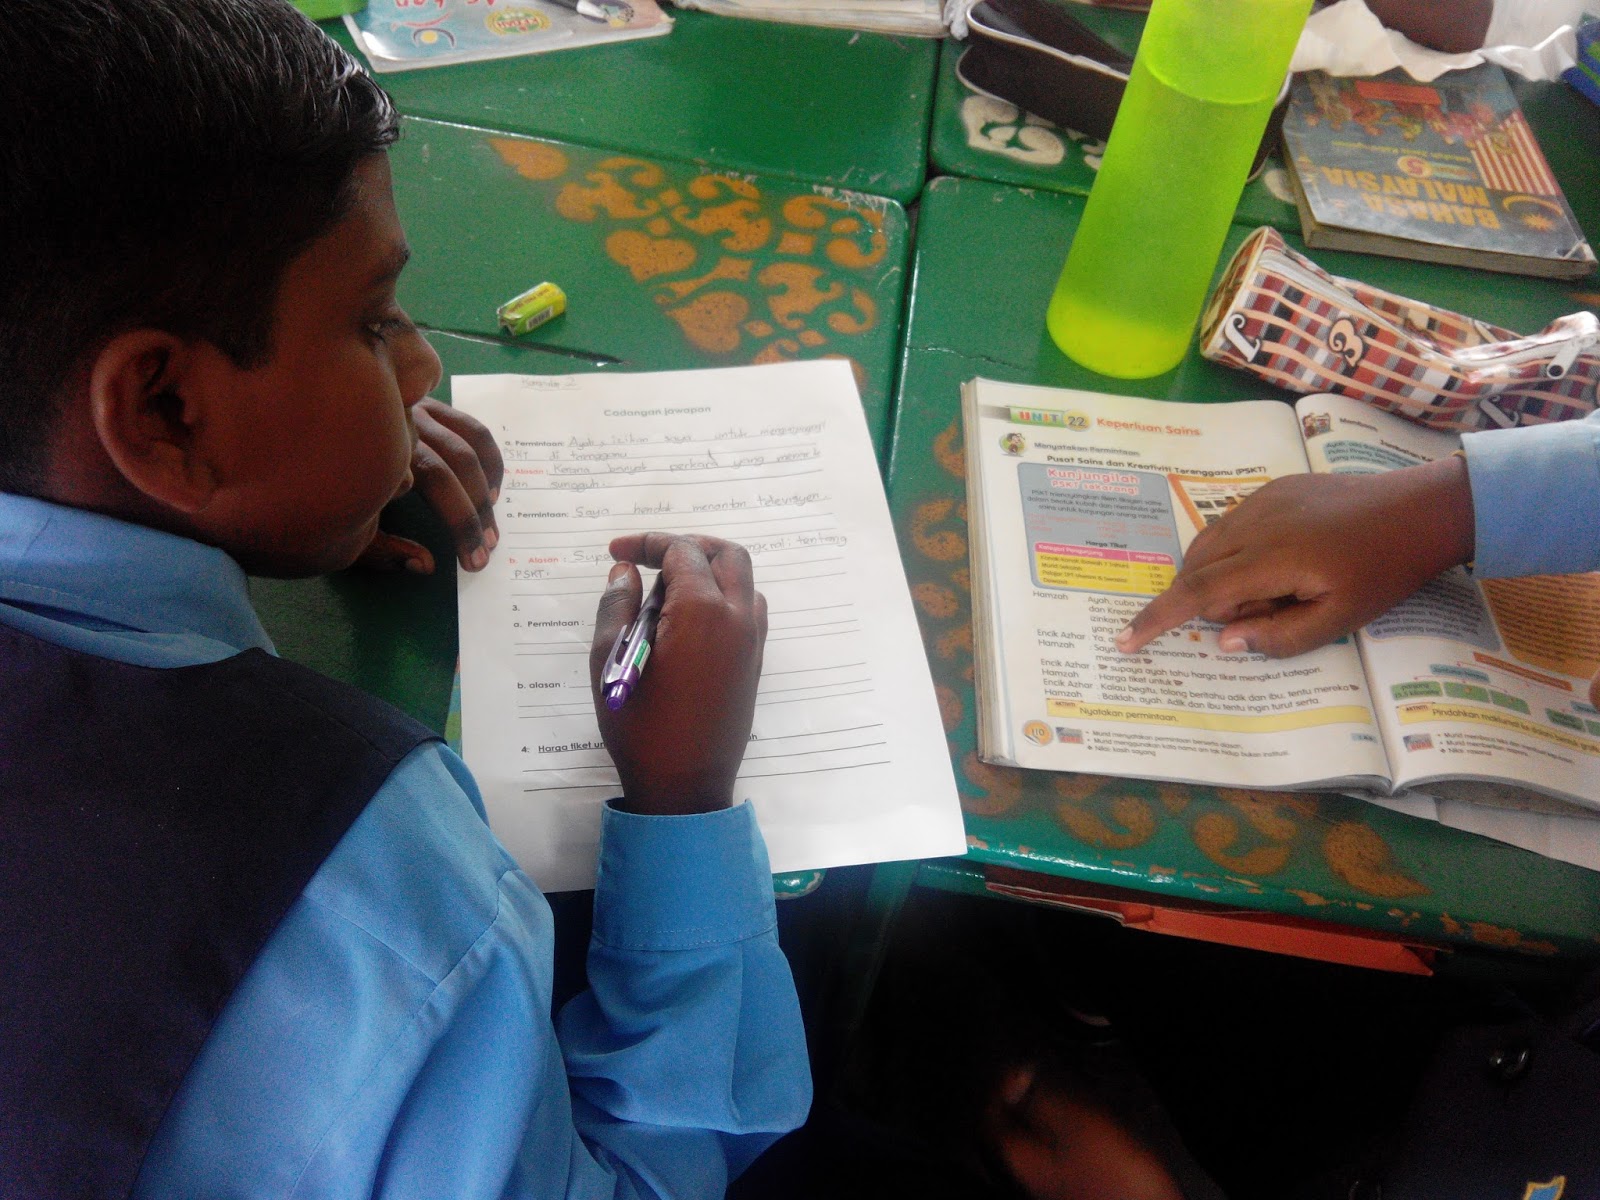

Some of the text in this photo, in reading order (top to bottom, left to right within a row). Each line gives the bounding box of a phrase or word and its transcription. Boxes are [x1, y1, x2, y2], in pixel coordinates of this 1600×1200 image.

[1321, 166, 1491, 207] MALAYSIA
[1362, 193, 1501, 230] BAHASA
[604, 405, 711, 417] Cadangan jawapan
[1019, 411, 1200, 435] UNIT 22 Keperluan Sains
[1048, 468, 1139, 484] Kunjungilah
[1127, 462, 1171, 472] Kreativiti
[1175, 467, 1233, 477] Terengganu
[1236, 466, 1266, 476] (PSKT)
[1052, 480, 1079, 488] PSKT
[576, 506, 610, 519] Saya
[1033, 591, 1068, 600] Hamzah
[1037, 629, 1058, 637] Encik
[1062, 631, 1085, 640] Azhar
[1038, 639, 1075, 648] Hamzah
[1094, 644, 1116, 653] Saya
[1216, 654, 1248, 663] supaya
[1096, 655, 1141, 664] mengenali
[1041, 659, 1062, 667] Encik
[1065, 661, 1090, 670] Azhar
[1110, 666, 1143, 675] supaya
[1145, 668, 1167, 676] ayah
[1169, 669, 1189, 678] tahu
[1191, 671, 1217, 681] harga
[1219, 673, 1237, 681] tiket
[1239, 671, 1281, 682] mengikut
[1042, 668, 1079, 678] Hamzah
[1099, 674, 1127, 683] Harga
[1148, 677, 1172, 686] untuk
[1043, 678, 1066, 687] Encik
[1068, 680, 1093, 689] Azhar
[1101, 684, 1126, 692] Kalau
[1160, 687, 1187, 698] tolong
[1189, 690, 1225, 701] beritahu
[1227, 692, 1246, 701] adik
[1249, 693, 1267, 701] dan
[1288, 689, 1312, 698] tentu
[1314, 684, 1349, 694] mereka
[1045, 688, 1082, 698] Hamzah
[1167, 698, 1184, 706] Adik
[1187, 700, 1205, 708] dan
[1207, 701, 1221, 710] ibu
[1223, 703, 1245, 712] tentu
[1248, 703, 1269, 713] ingin
[1271, 702, 1293, 711] turut
[1080, 707, 1179, 722] Nyatakan permintaan.
[538, 744, 568, 753] Harga
[571, 741, 591, 750] tiket
